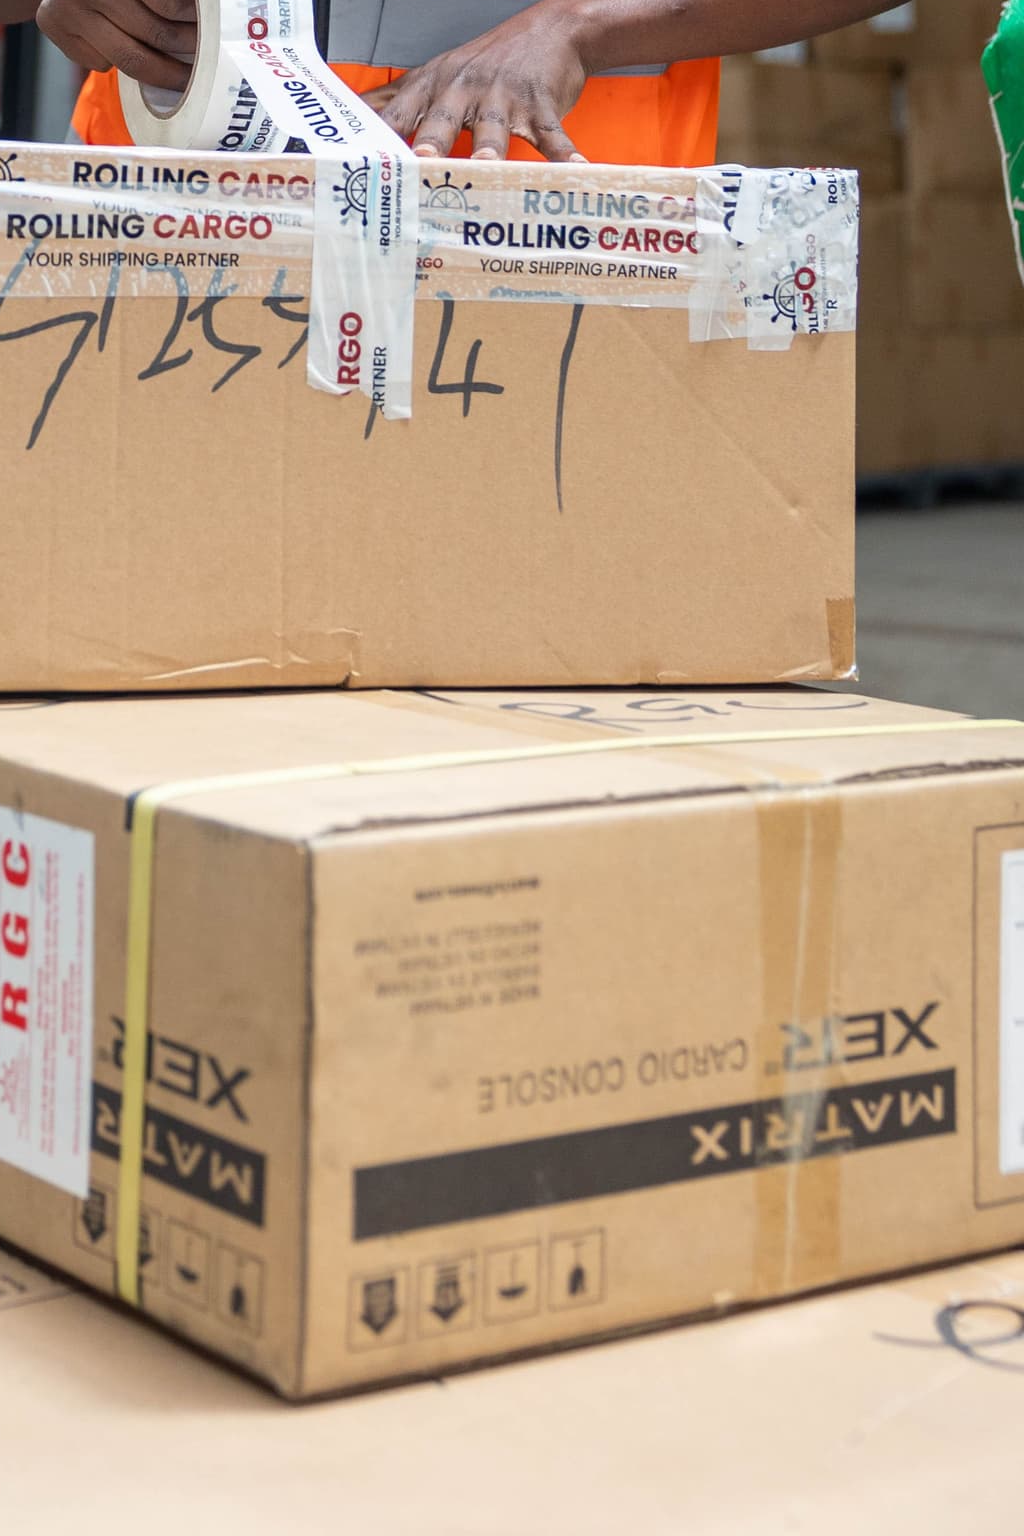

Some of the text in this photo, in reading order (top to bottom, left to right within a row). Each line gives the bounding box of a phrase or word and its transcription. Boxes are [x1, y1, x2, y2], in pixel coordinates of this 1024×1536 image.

[73, 161, 315, 201] ROLLING CARG
[379, 184, 392, 246] ROLLING
[523, 189, 650, 219] ROLLING
[7, 213, 144, 239] ROLLING
[153, 214, 273, 240] CARGO
[463, 221, 590, 250] ROLLING
[26, 252, 239, 268] YOUR SHIPPING PARTNER
[479, 258, 678, 280] YOUR SHIPPING PARTNER
[477, 1001, 942, 1114] XER CARDIO CONSOLE
[690, 1084, 946, 1165] MATRIX
